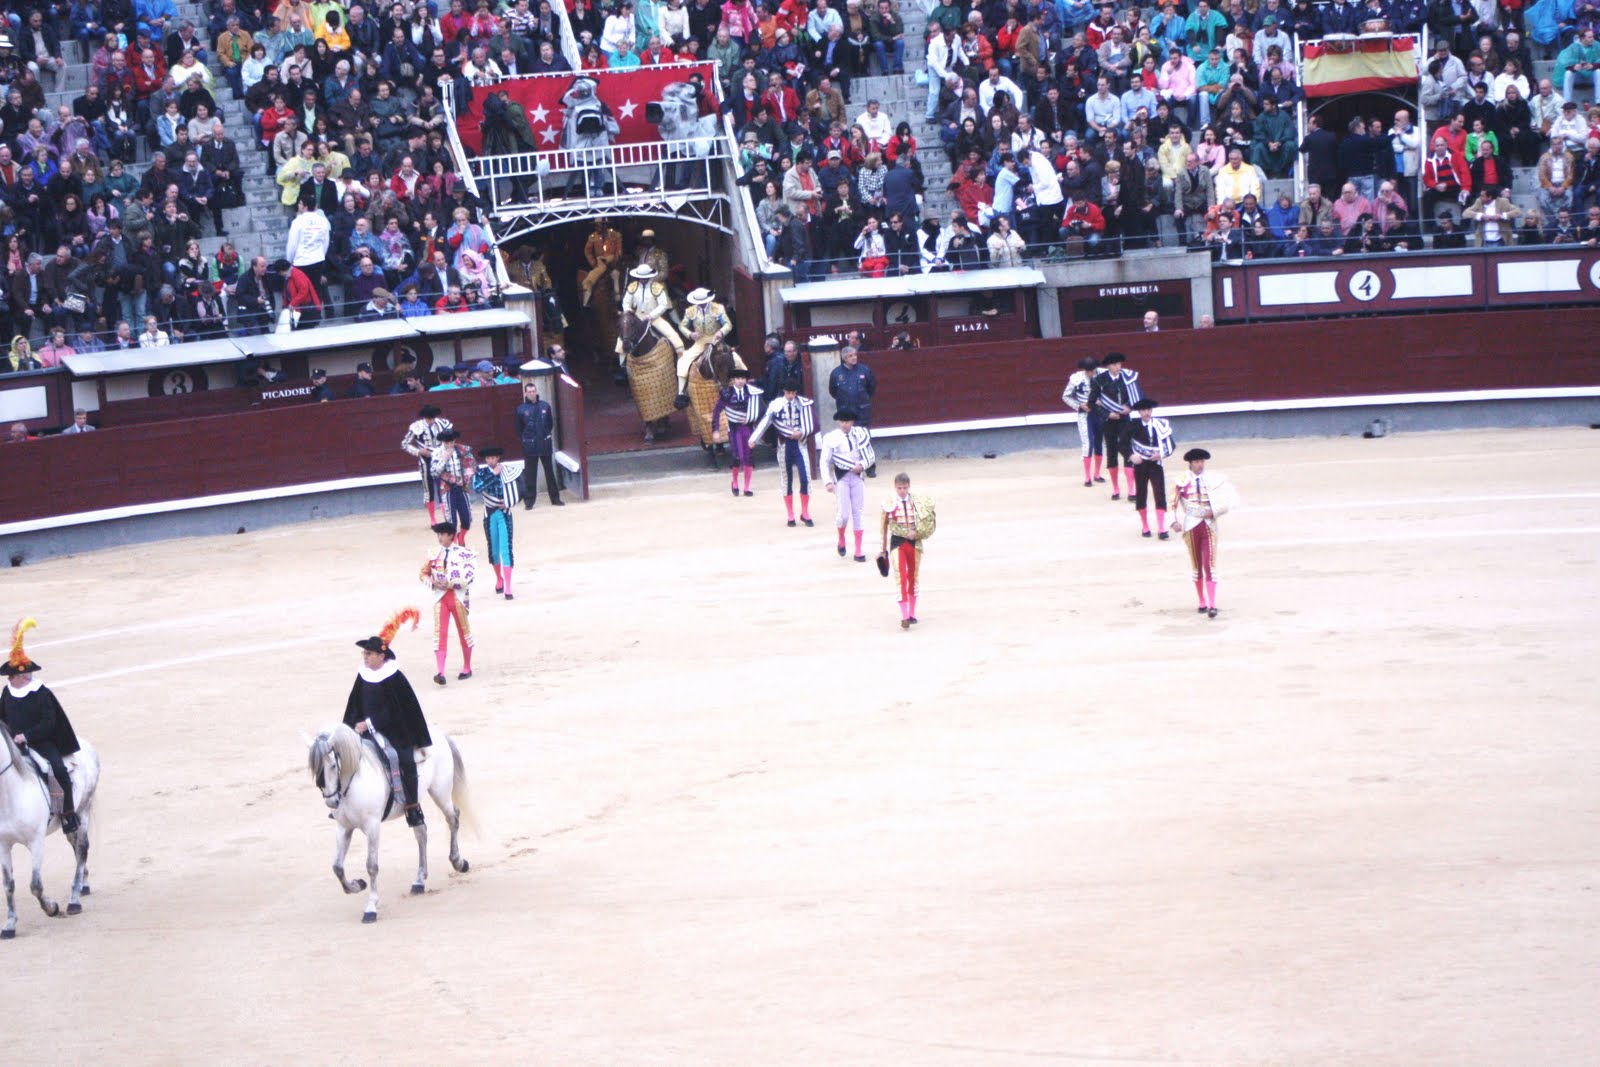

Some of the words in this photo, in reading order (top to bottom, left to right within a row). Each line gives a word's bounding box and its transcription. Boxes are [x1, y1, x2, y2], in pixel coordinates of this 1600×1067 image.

[1099, 285, 1159, 296] ENFERMERIA
[1358, 275, 1371, 296] 4
[954, 322, 990, 333] PLAZA
[172, 373, 187, 395] 3
